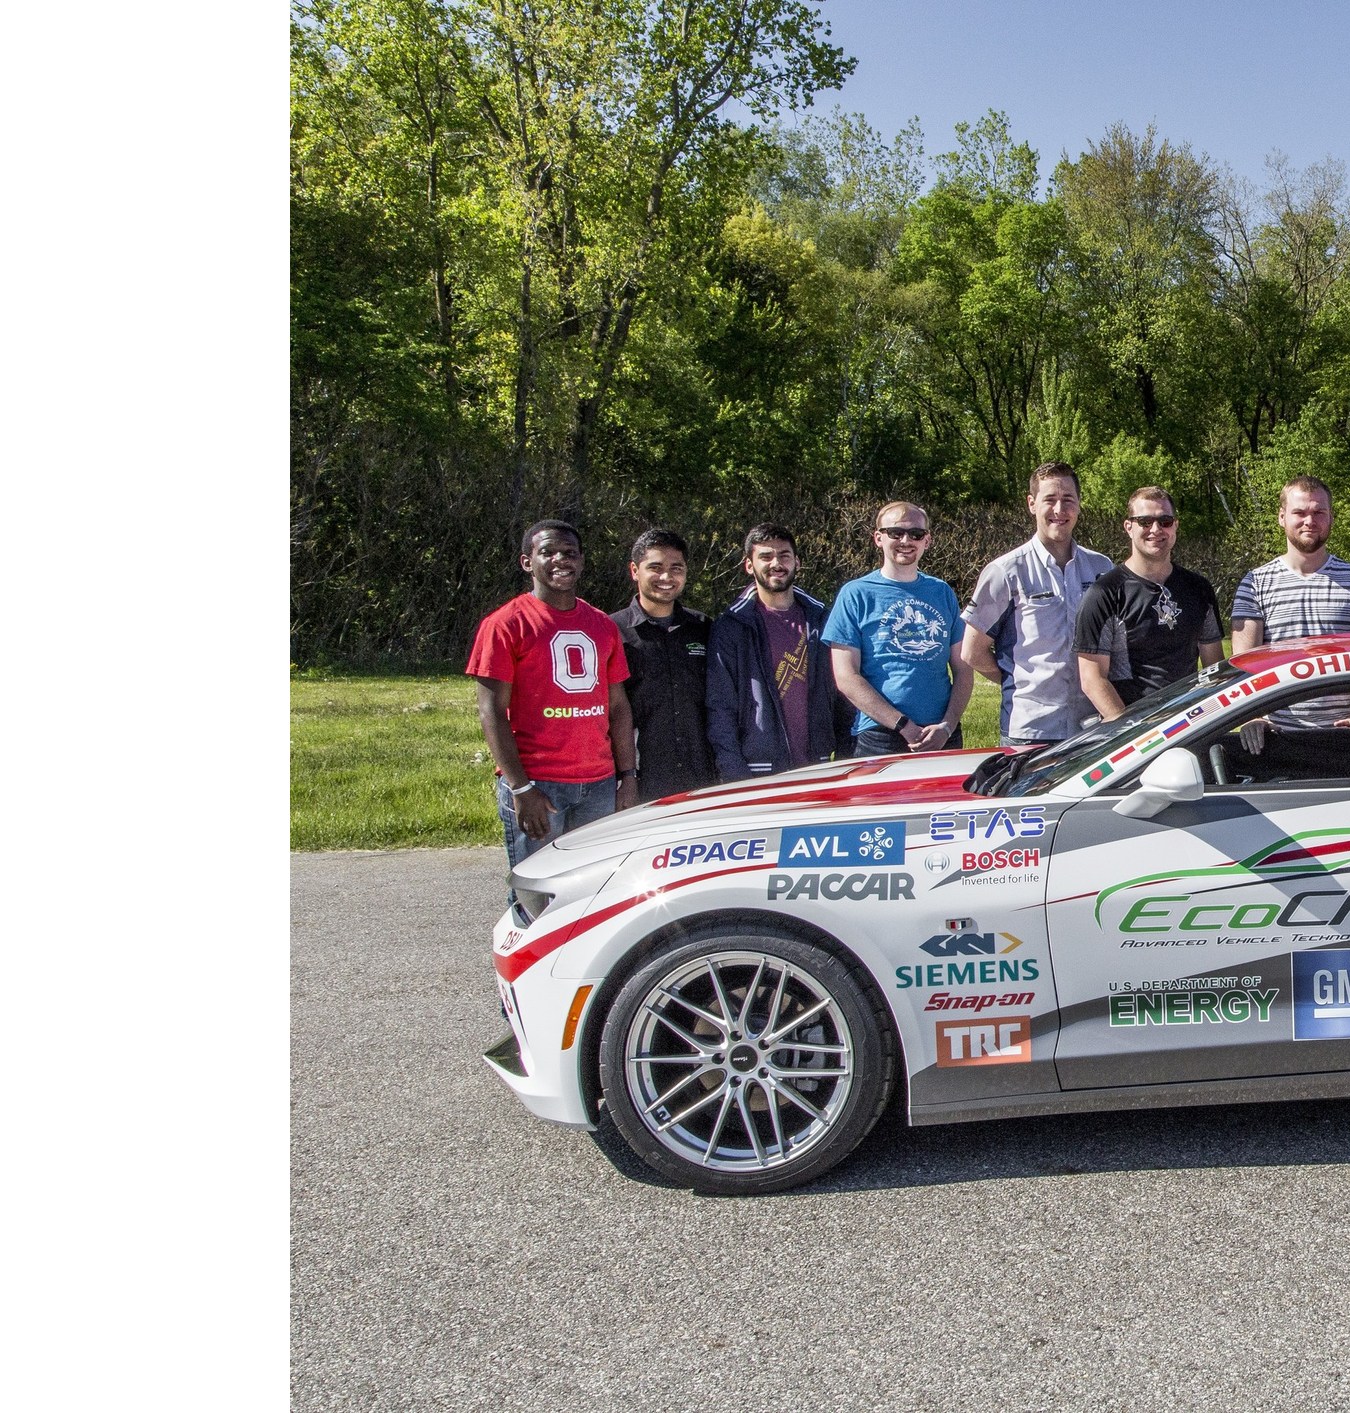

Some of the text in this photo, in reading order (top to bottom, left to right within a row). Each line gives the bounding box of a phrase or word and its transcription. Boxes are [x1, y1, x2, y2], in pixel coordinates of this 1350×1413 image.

[905, 599, 947, 626] COMPETITION
[550, 630, 598, 694] O
[930, 807, 1046, 841] ETAS
[652, 839, 767, 870] dSPACE
[788, 836, 849, 859] AVL
[962, 849, 1040, 871] BOSCH
[767, 872, 916, 901] PACCAR
[962, 873, 1040, 886] Invented for life
[895, 959, 1040, 989] SIEMENS
[1108, 976, 1262, 992] U.S. DEPARTMENT OF
[923, 992, 1036, 1012] Snap-on
[1109, 988, 1280, 1028] ENERGY
[943, 1022, 1022, 1060] TRC
